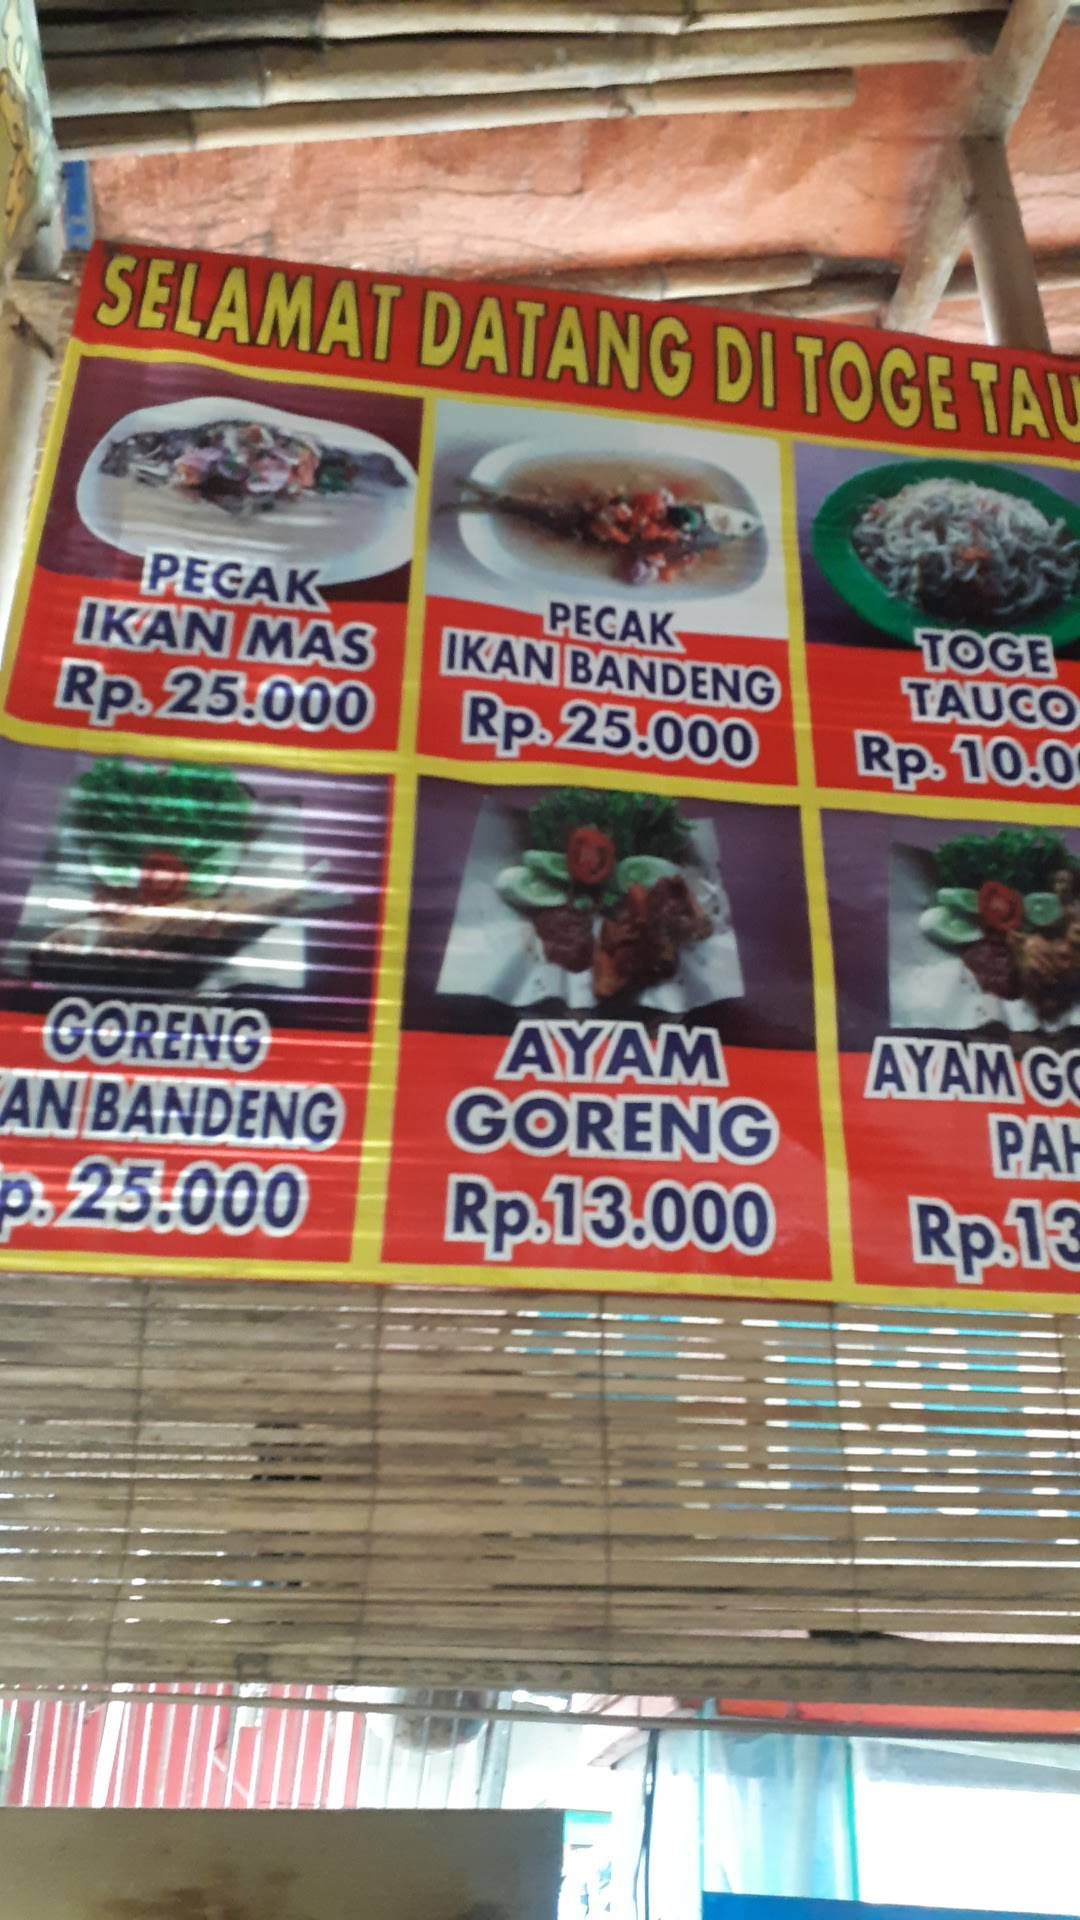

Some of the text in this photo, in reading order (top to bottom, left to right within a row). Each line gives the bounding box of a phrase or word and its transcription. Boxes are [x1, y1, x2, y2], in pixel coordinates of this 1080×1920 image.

[95, 253, 404, 362] SELAMAT
[418, 290, 694, 398] DATANG
[713, 325, 777, 409] DI
[794, 334, 959, 432] TOGE
[146, 551, 325, 609] PECAK
[78, 602, 372, 668] IKAN MAS
[548, 600, 678, 649] PECAK
[919, 631, 1052, 675] TOGE
[444, 631, 778, 709] IKAN BANDENG
[905, 680, 1079, 728] TAUCO
[859, 733, 1080, 787] Rp. 10.0
[46, 1002, 265, 1068] GORENG
[502, 1024, 724, 1082] AYAM
[870, 1041, 1020, 1099] AYAM
[0, 1076, 341, 1146] AN BANDENG
[451, 1090, 776, 1161] GORENG
